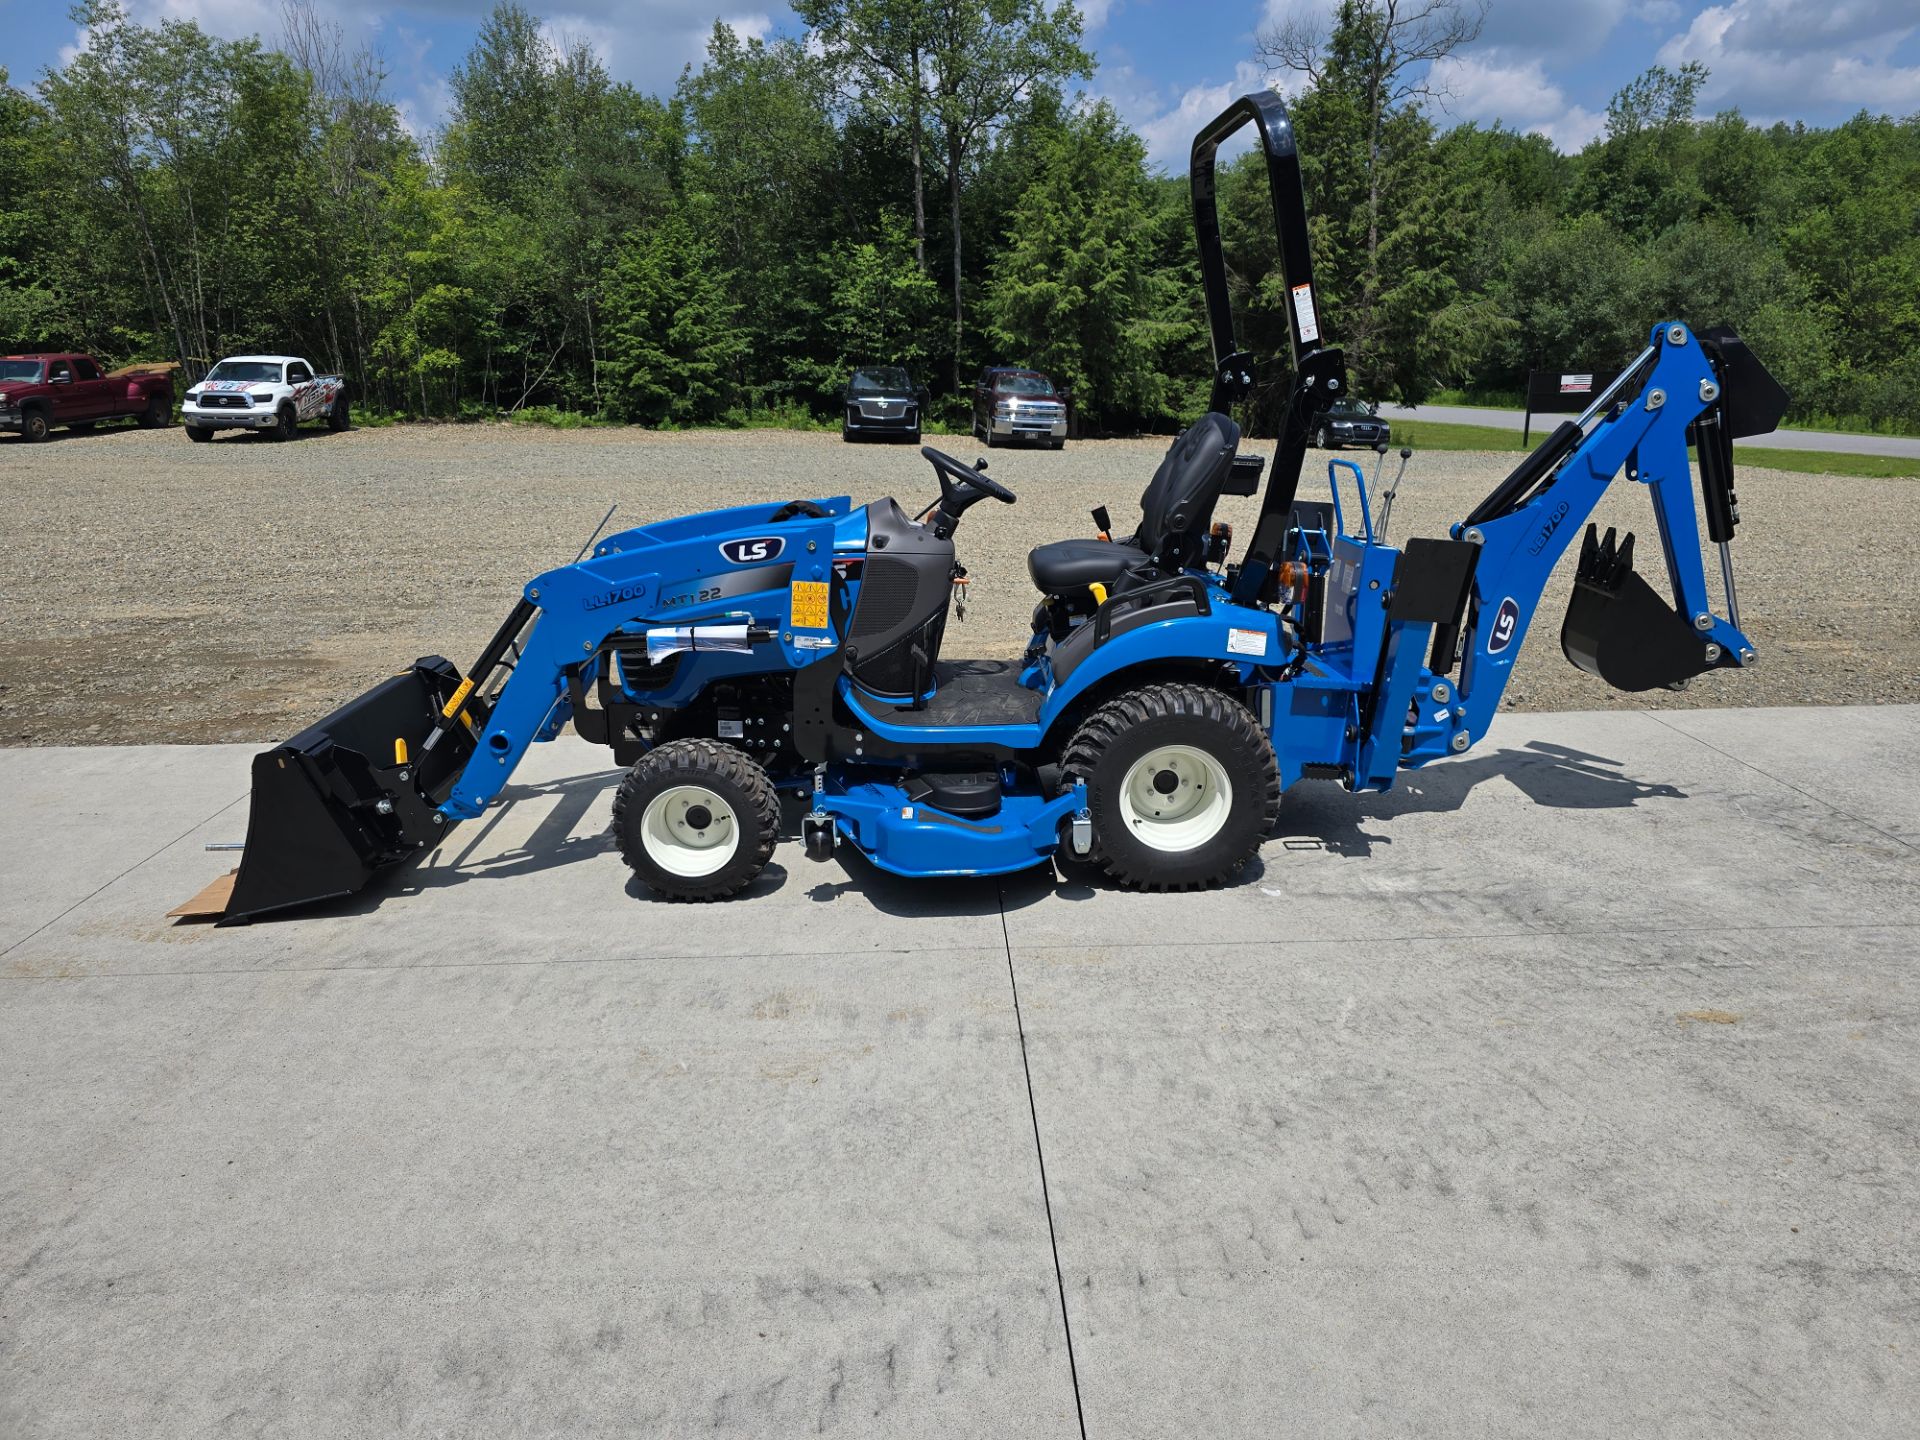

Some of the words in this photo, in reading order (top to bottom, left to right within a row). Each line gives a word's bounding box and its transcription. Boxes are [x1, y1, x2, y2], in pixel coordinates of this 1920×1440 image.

[1529, 501, 1569, 556] LB1700
[738, 542, 767, 561] LS
[583, 584, 646, 611] LL1700
[1496, 614, 1514, 641] LS
